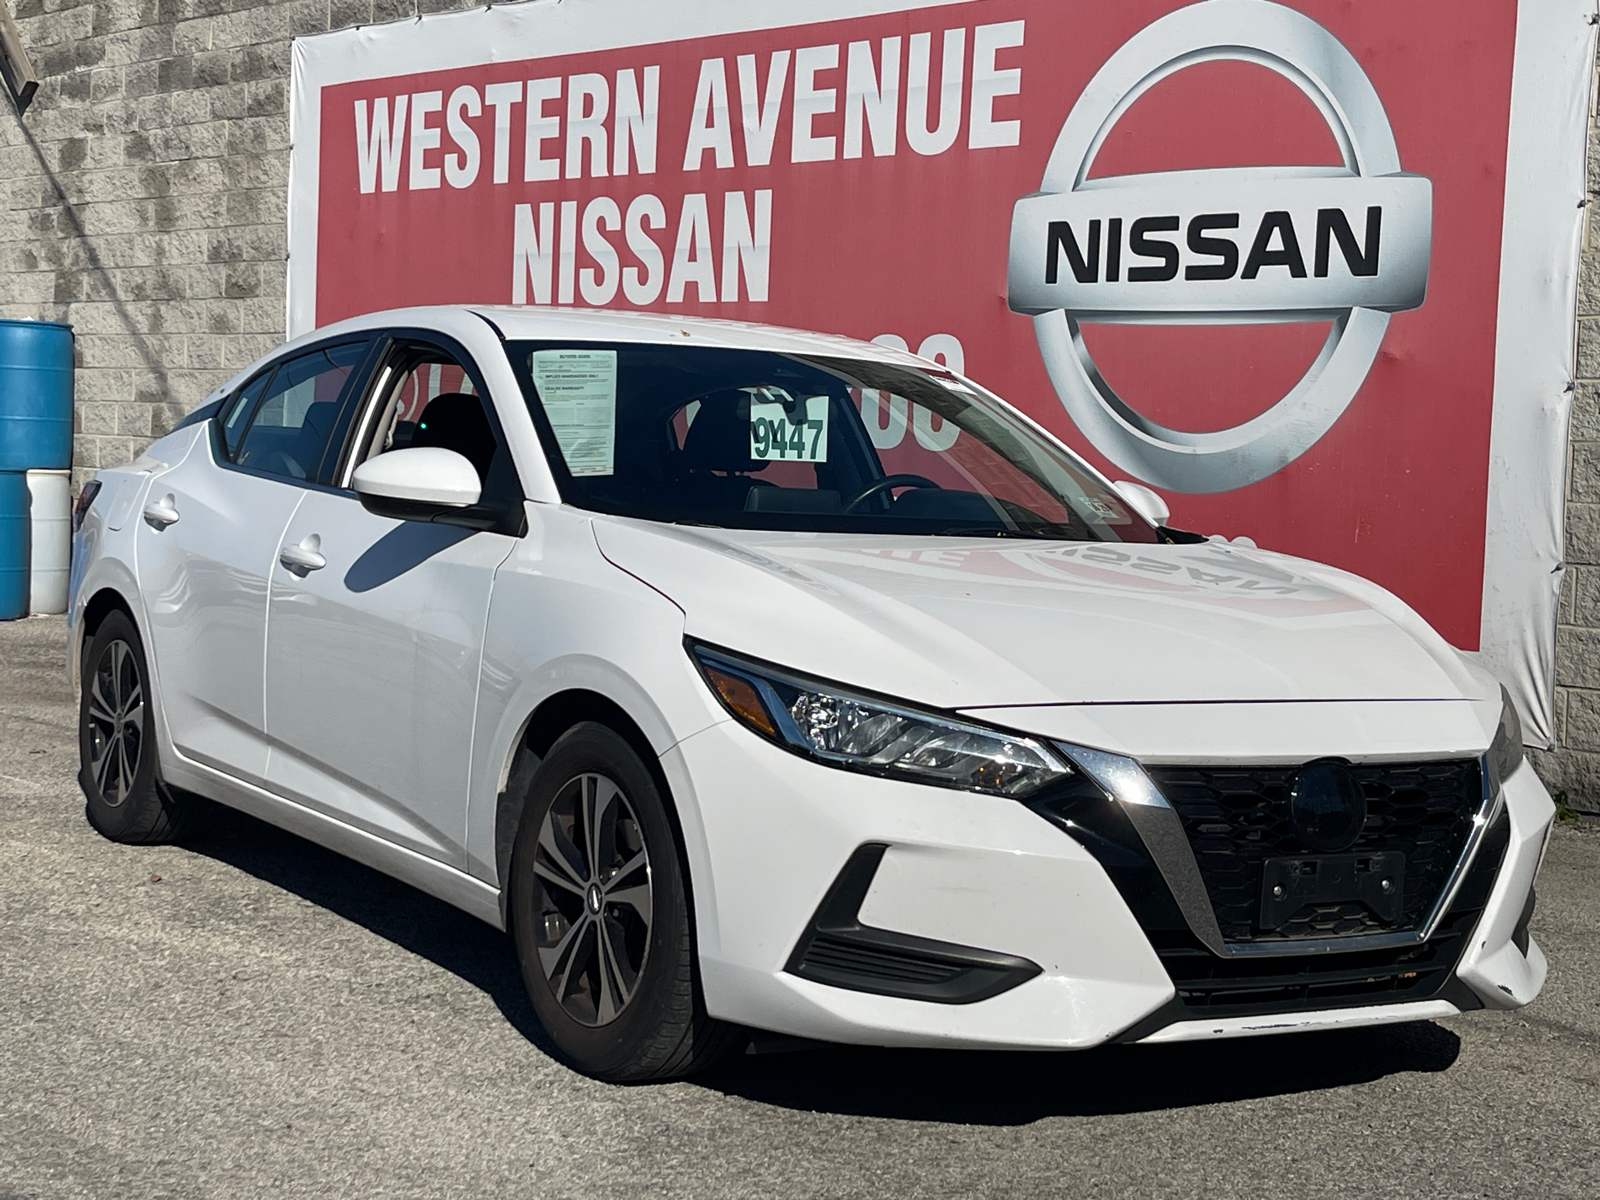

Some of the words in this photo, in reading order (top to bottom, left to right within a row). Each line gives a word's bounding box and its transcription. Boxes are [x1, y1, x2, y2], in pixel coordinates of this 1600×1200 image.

[353, 64, 660, 194] WESTERN
[683, 19, 1026, 171] AVENUE
[512, 189, 773, 305] NISSAN
[1045, 206, 1382, 284] NISSAN
[754, 417, 824, 459] 9447
